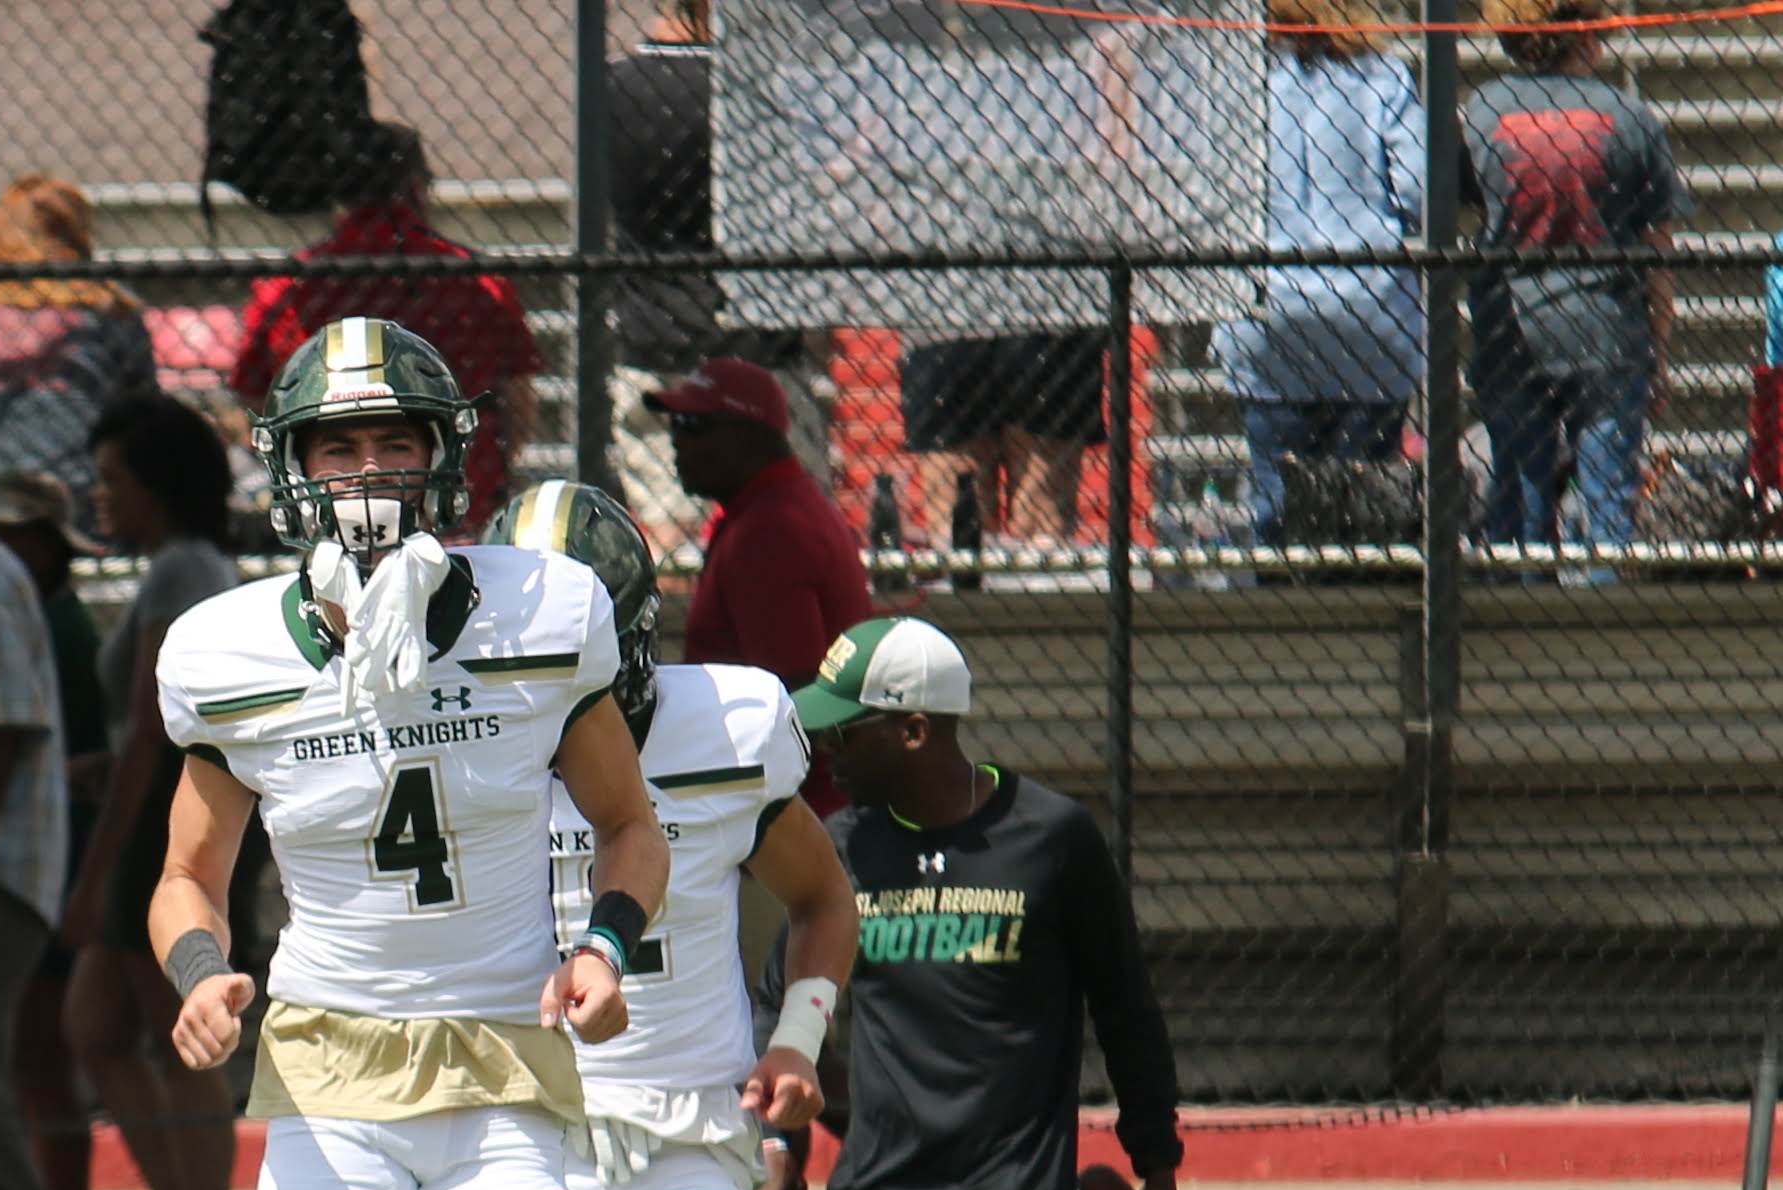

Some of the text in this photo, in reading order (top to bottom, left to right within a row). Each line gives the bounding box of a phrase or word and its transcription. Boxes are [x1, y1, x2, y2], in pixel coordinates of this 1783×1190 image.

[293, 715, 500, 760] GREEN KNIGHTS
[372, 765, 456, 907] 4
[939, 886, 1026, 915] REGIONAL
